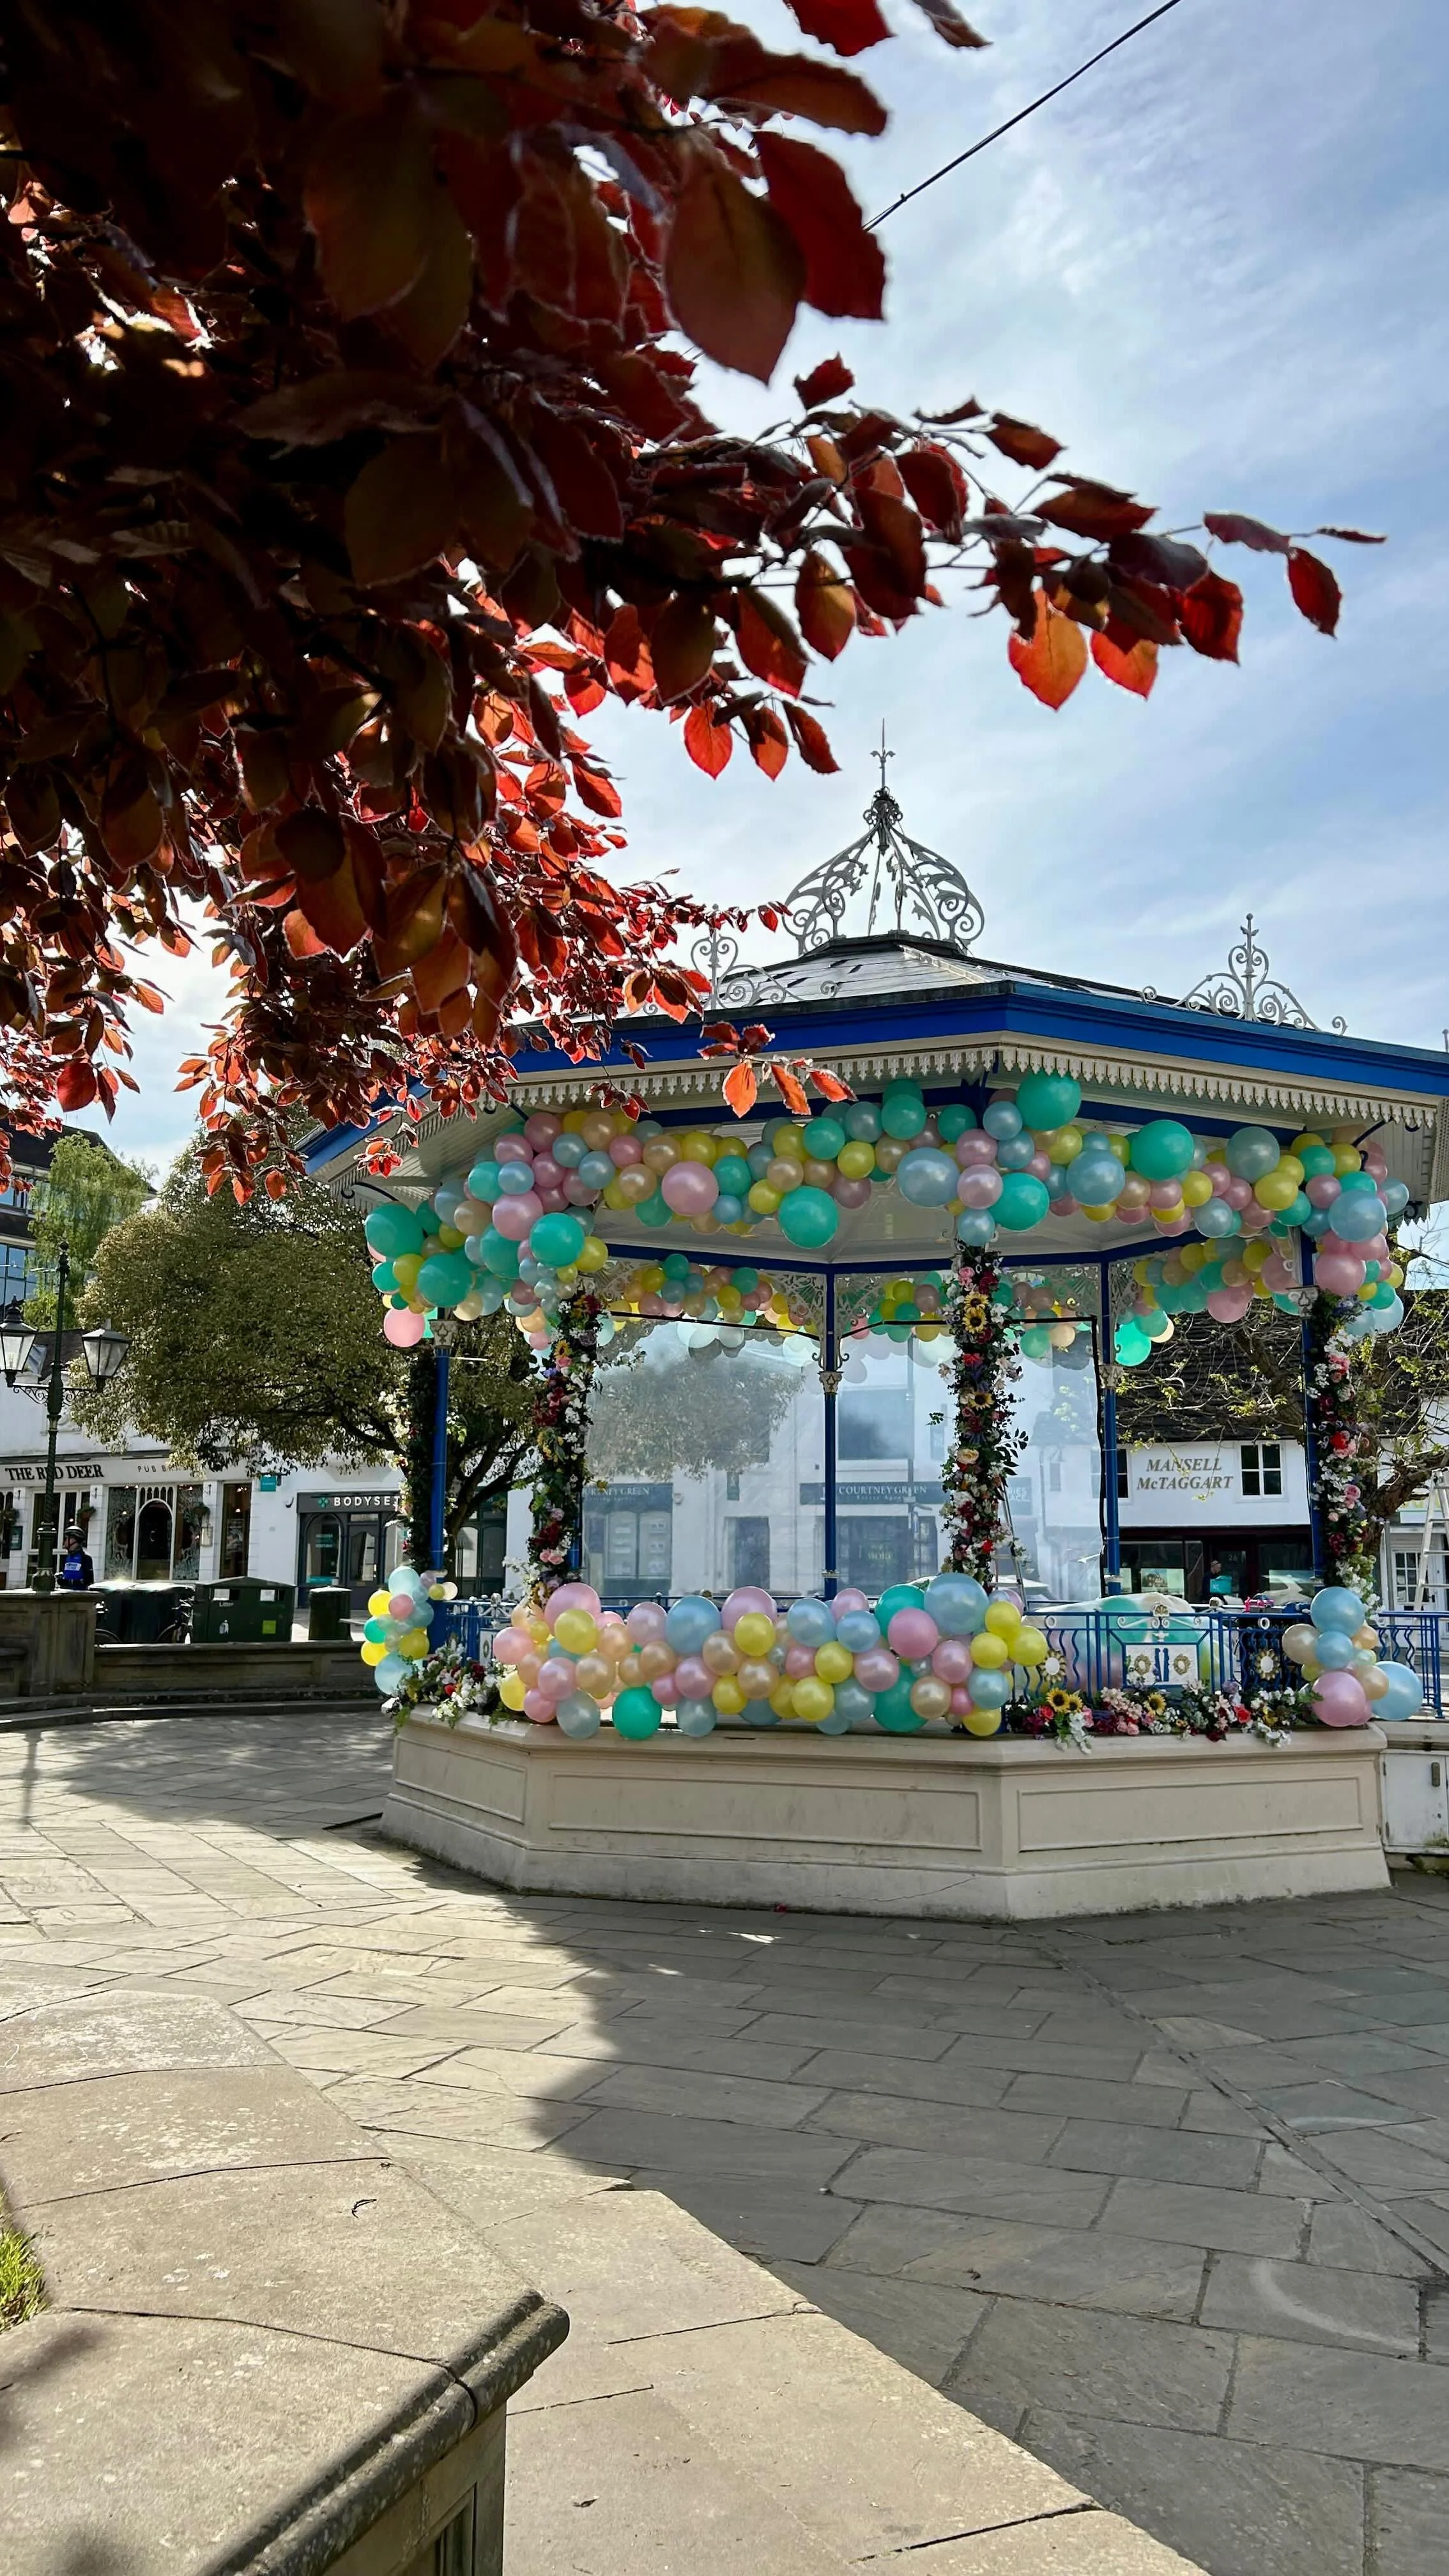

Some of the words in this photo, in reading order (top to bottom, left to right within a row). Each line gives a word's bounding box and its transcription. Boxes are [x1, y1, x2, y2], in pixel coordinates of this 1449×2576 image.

[5, 1467, 34, 1480] THE
[35, 1466, 63, 1480] RD
[65, 1464, 104, 1478] DEER
[1146, 1458, 1222, 1472] MANSELL
[838, 1485, 891, 1494] COURTNEY
[894, 1485, 927, 1494] GREN
[1137, 1476, 1234, 1490] McTAGGART
